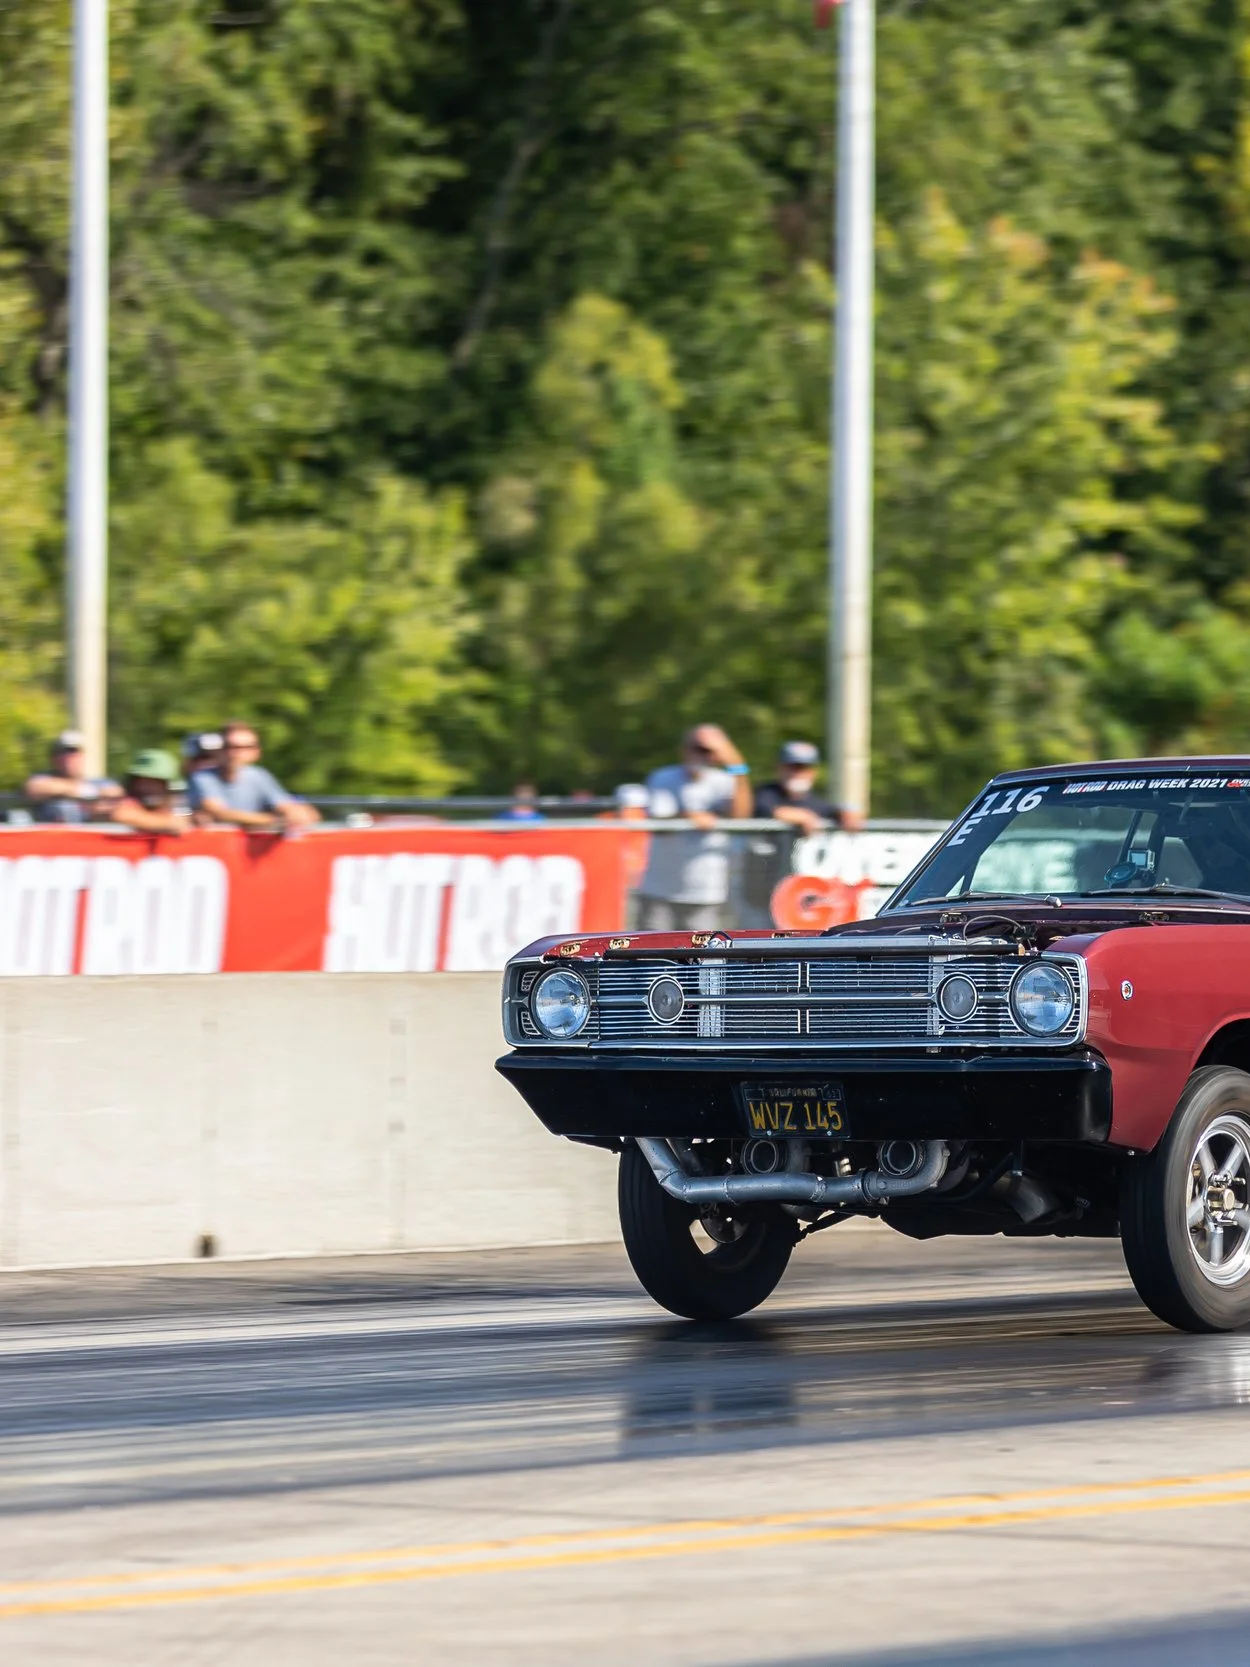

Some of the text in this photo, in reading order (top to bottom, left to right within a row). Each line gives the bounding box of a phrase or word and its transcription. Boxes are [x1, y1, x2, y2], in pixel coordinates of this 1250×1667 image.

[1107, 780, 1145, 791] DRAG
[1148, 779, 1190, 789] WEEK
[1189, 778, 1228, 789] 2021
[970, 785, 1050, 818] 116
[946, 818, 982, 847] E
[0, 854, 90, 976] OT
[748, 1101, 843, 1131] WVZ 145
